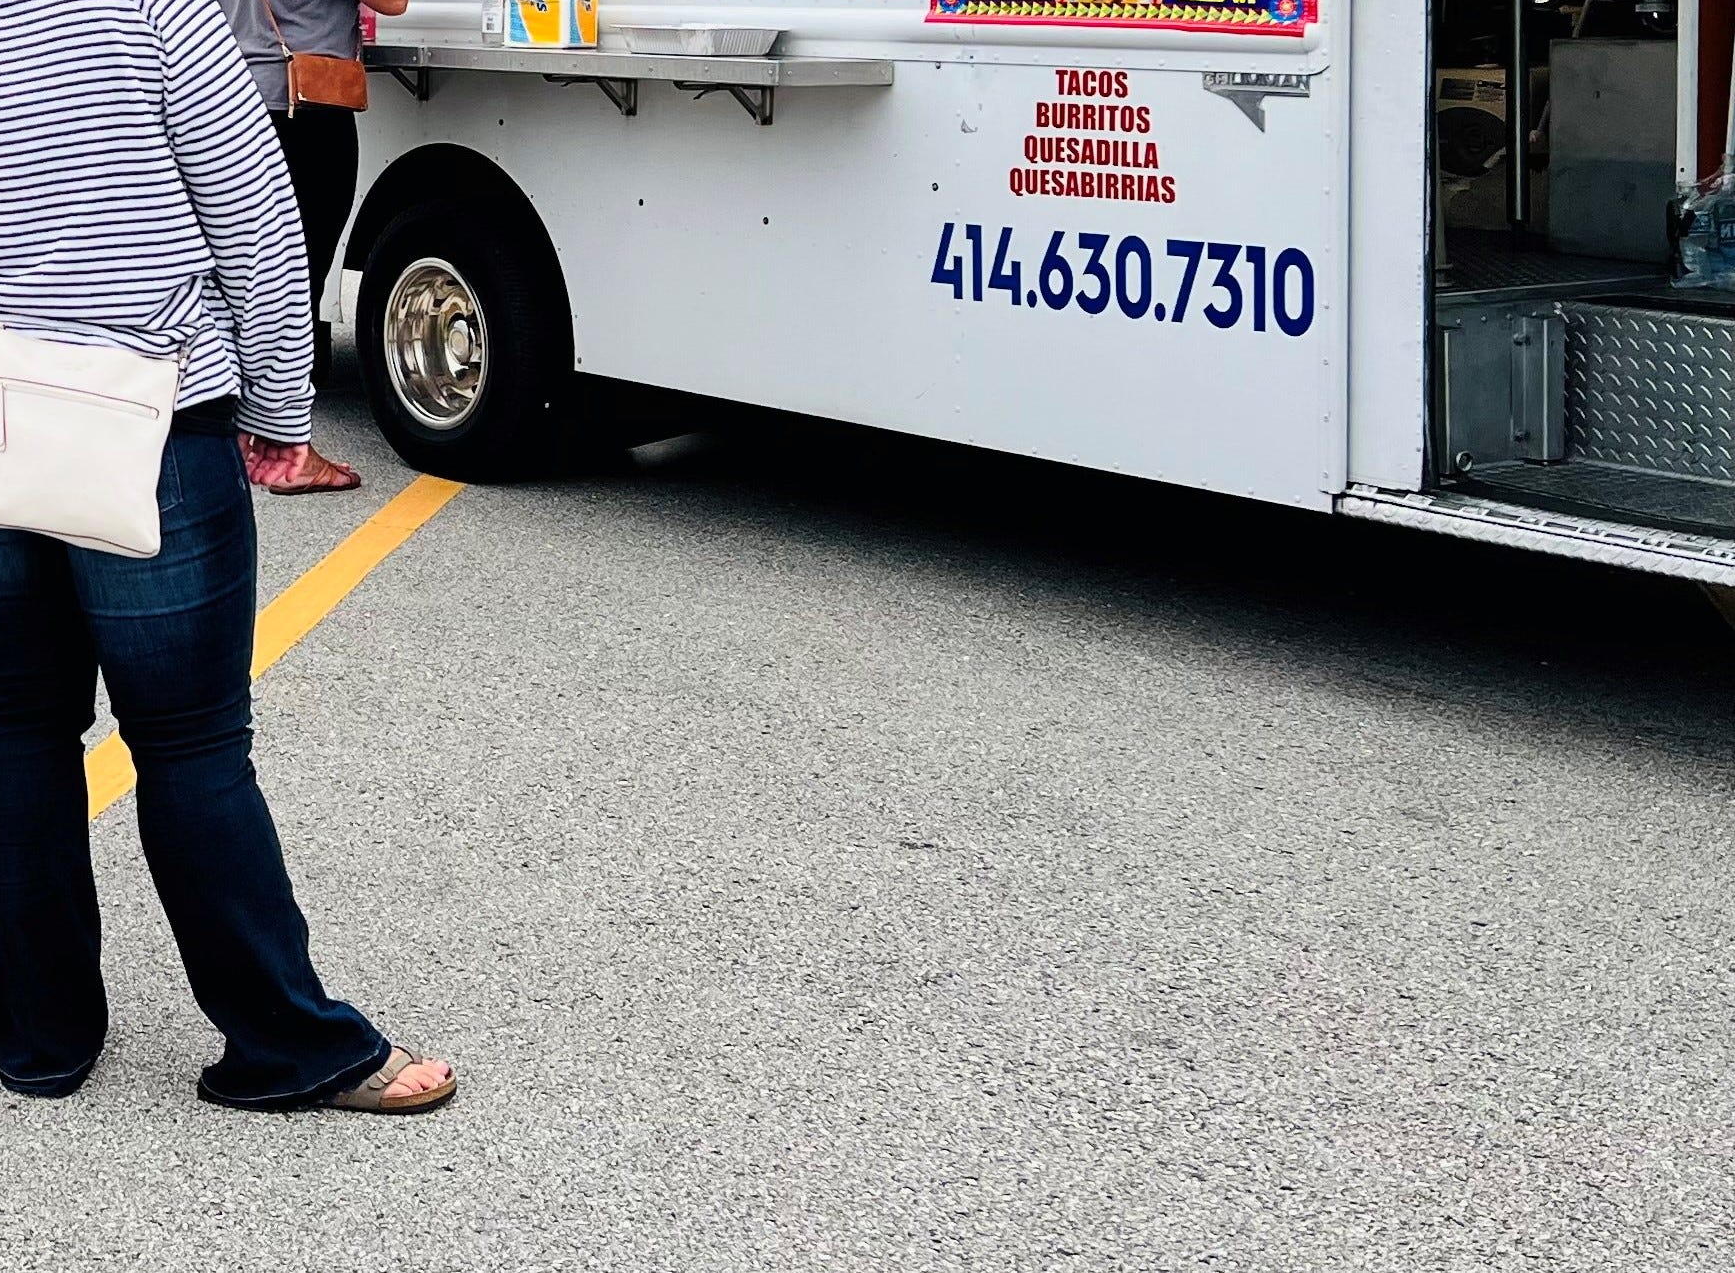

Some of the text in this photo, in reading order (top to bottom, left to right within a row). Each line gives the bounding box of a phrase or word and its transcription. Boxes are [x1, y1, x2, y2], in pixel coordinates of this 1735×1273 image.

[1055, 69, 1129, 98] TACOS
[1035, 101, 1151, 134] BURRITOS
[1023, 134, 1160, 169] QUESADILLA
[1009, 167, 1176, 204] QUESABIRRIAS
[930, 222, 1315, 337] 414.630.7310
